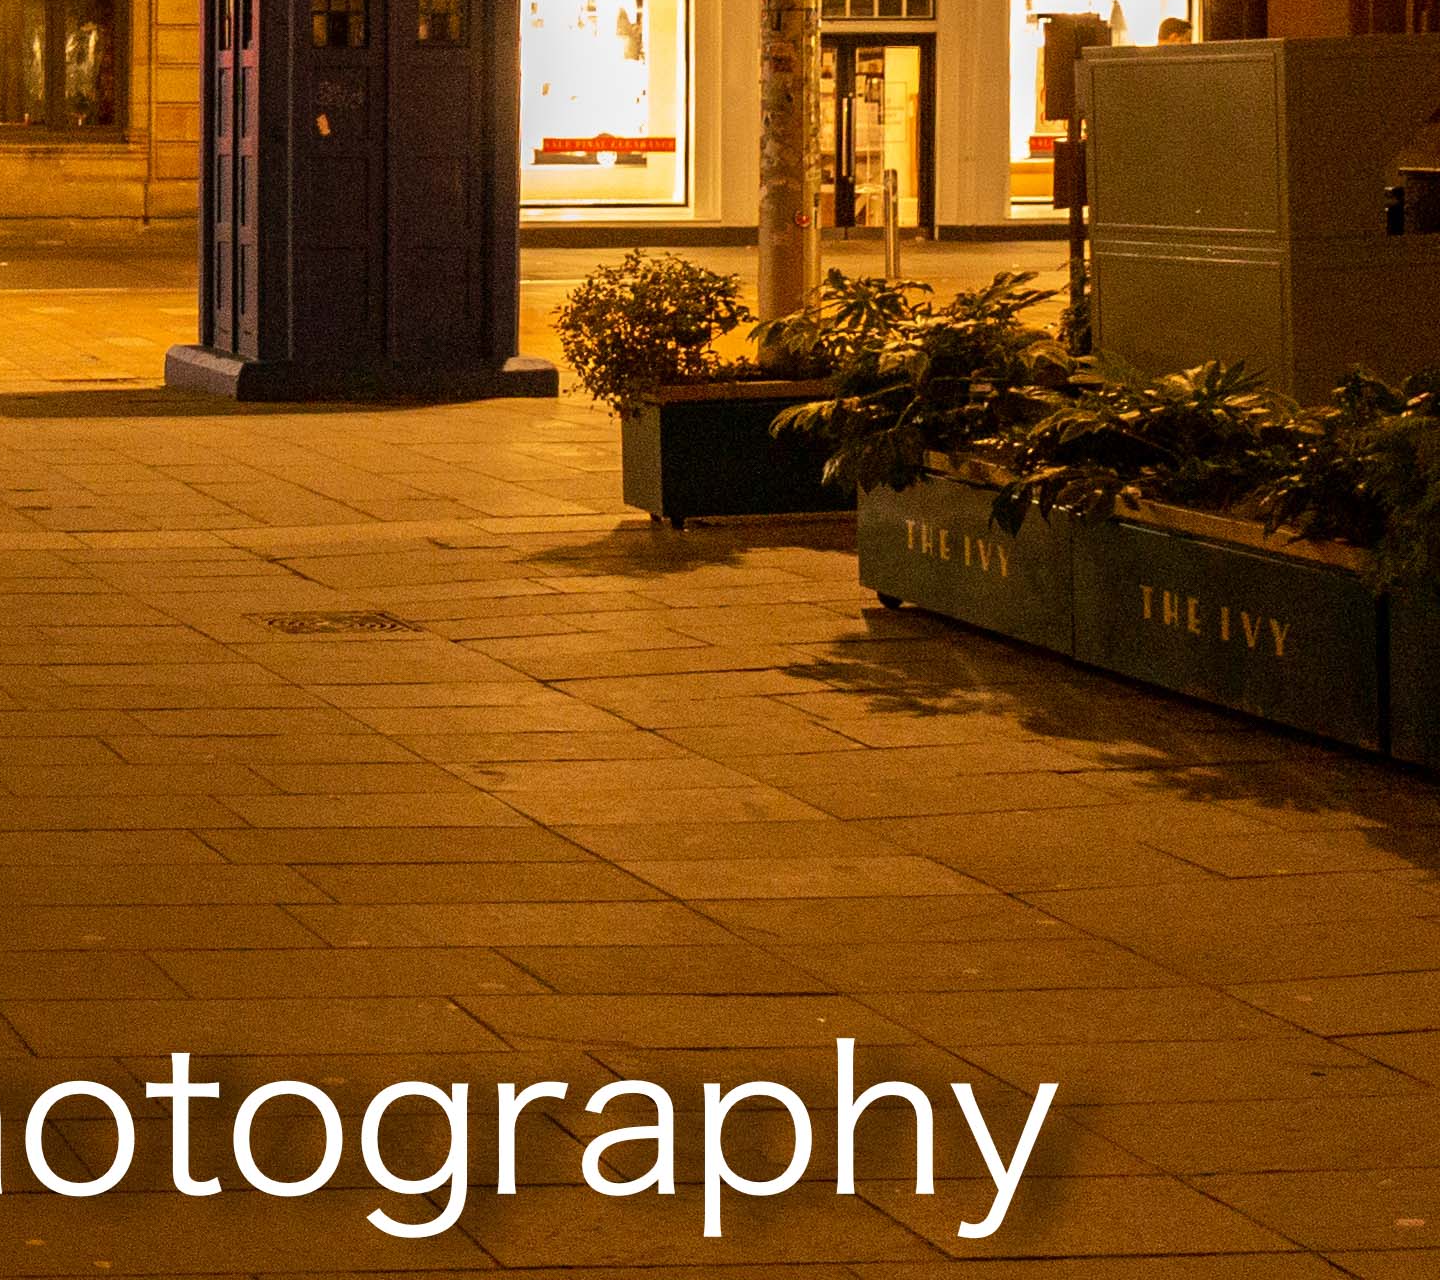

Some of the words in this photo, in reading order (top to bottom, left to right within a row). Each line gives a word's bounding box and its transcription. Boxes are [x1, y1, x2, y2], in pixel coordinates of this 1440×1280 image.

[905, 519, 950, 561] THE
[964, 534, 1009, 577] IVY
[1139, 583, 1201, 635] THE
[1221, 607, 1291, 667] IVY
